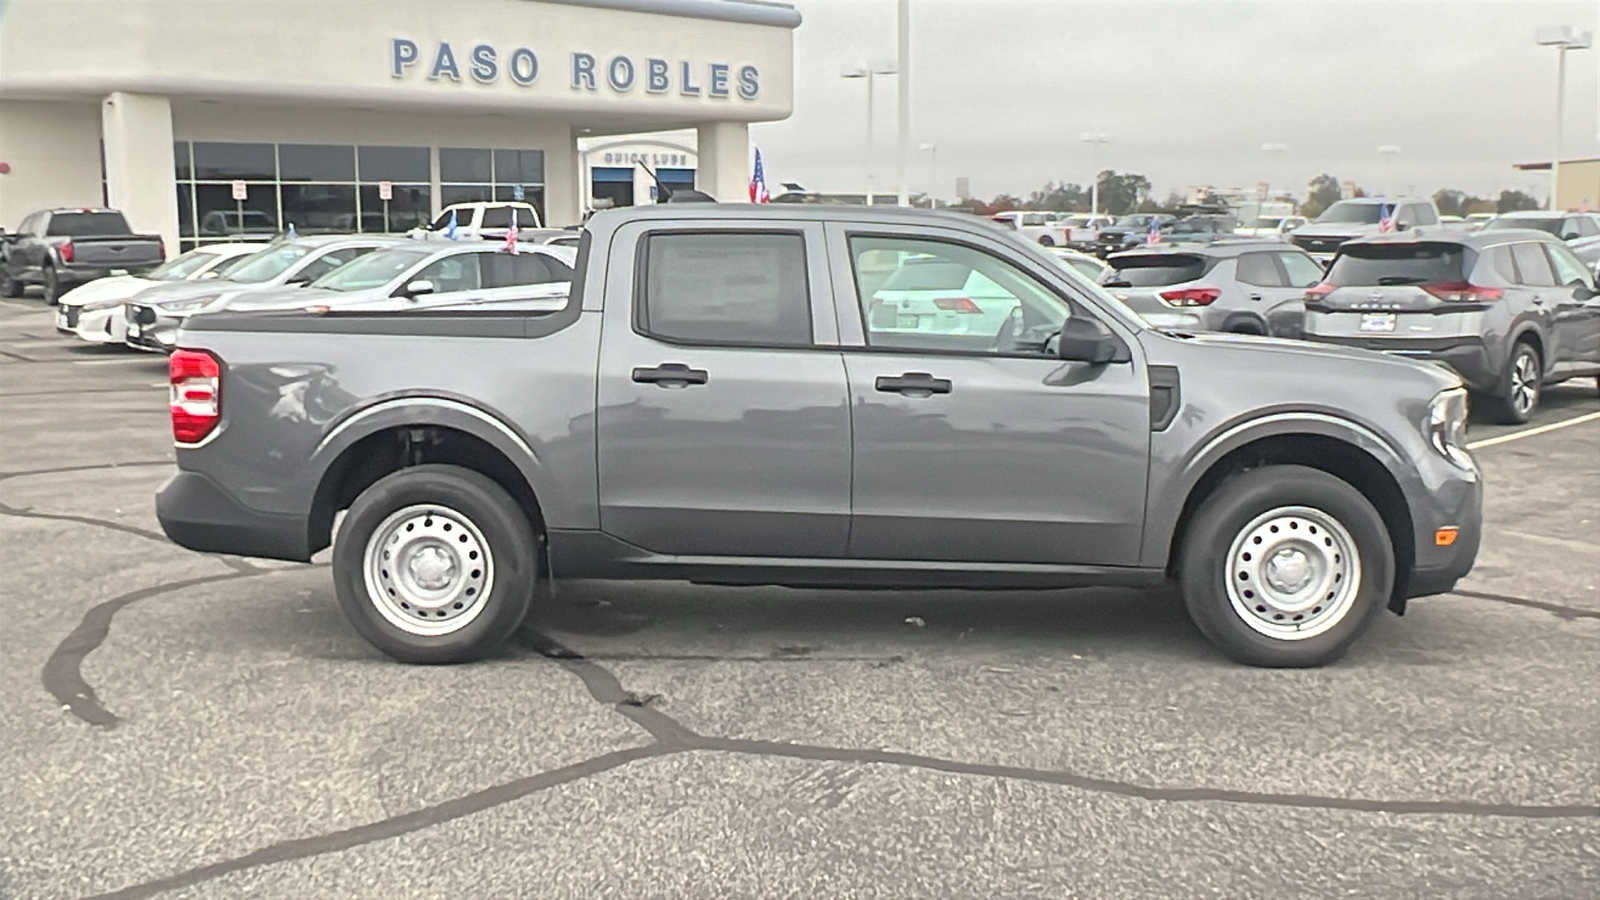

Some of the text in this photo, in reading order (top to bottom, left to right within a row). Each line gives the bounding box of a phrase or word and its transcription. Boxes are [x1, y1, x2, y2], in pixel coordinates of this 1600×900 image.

[392, 39, 761, 99] PASO ROBLES
[604, 152, 687, 166] QUICK LUBE
